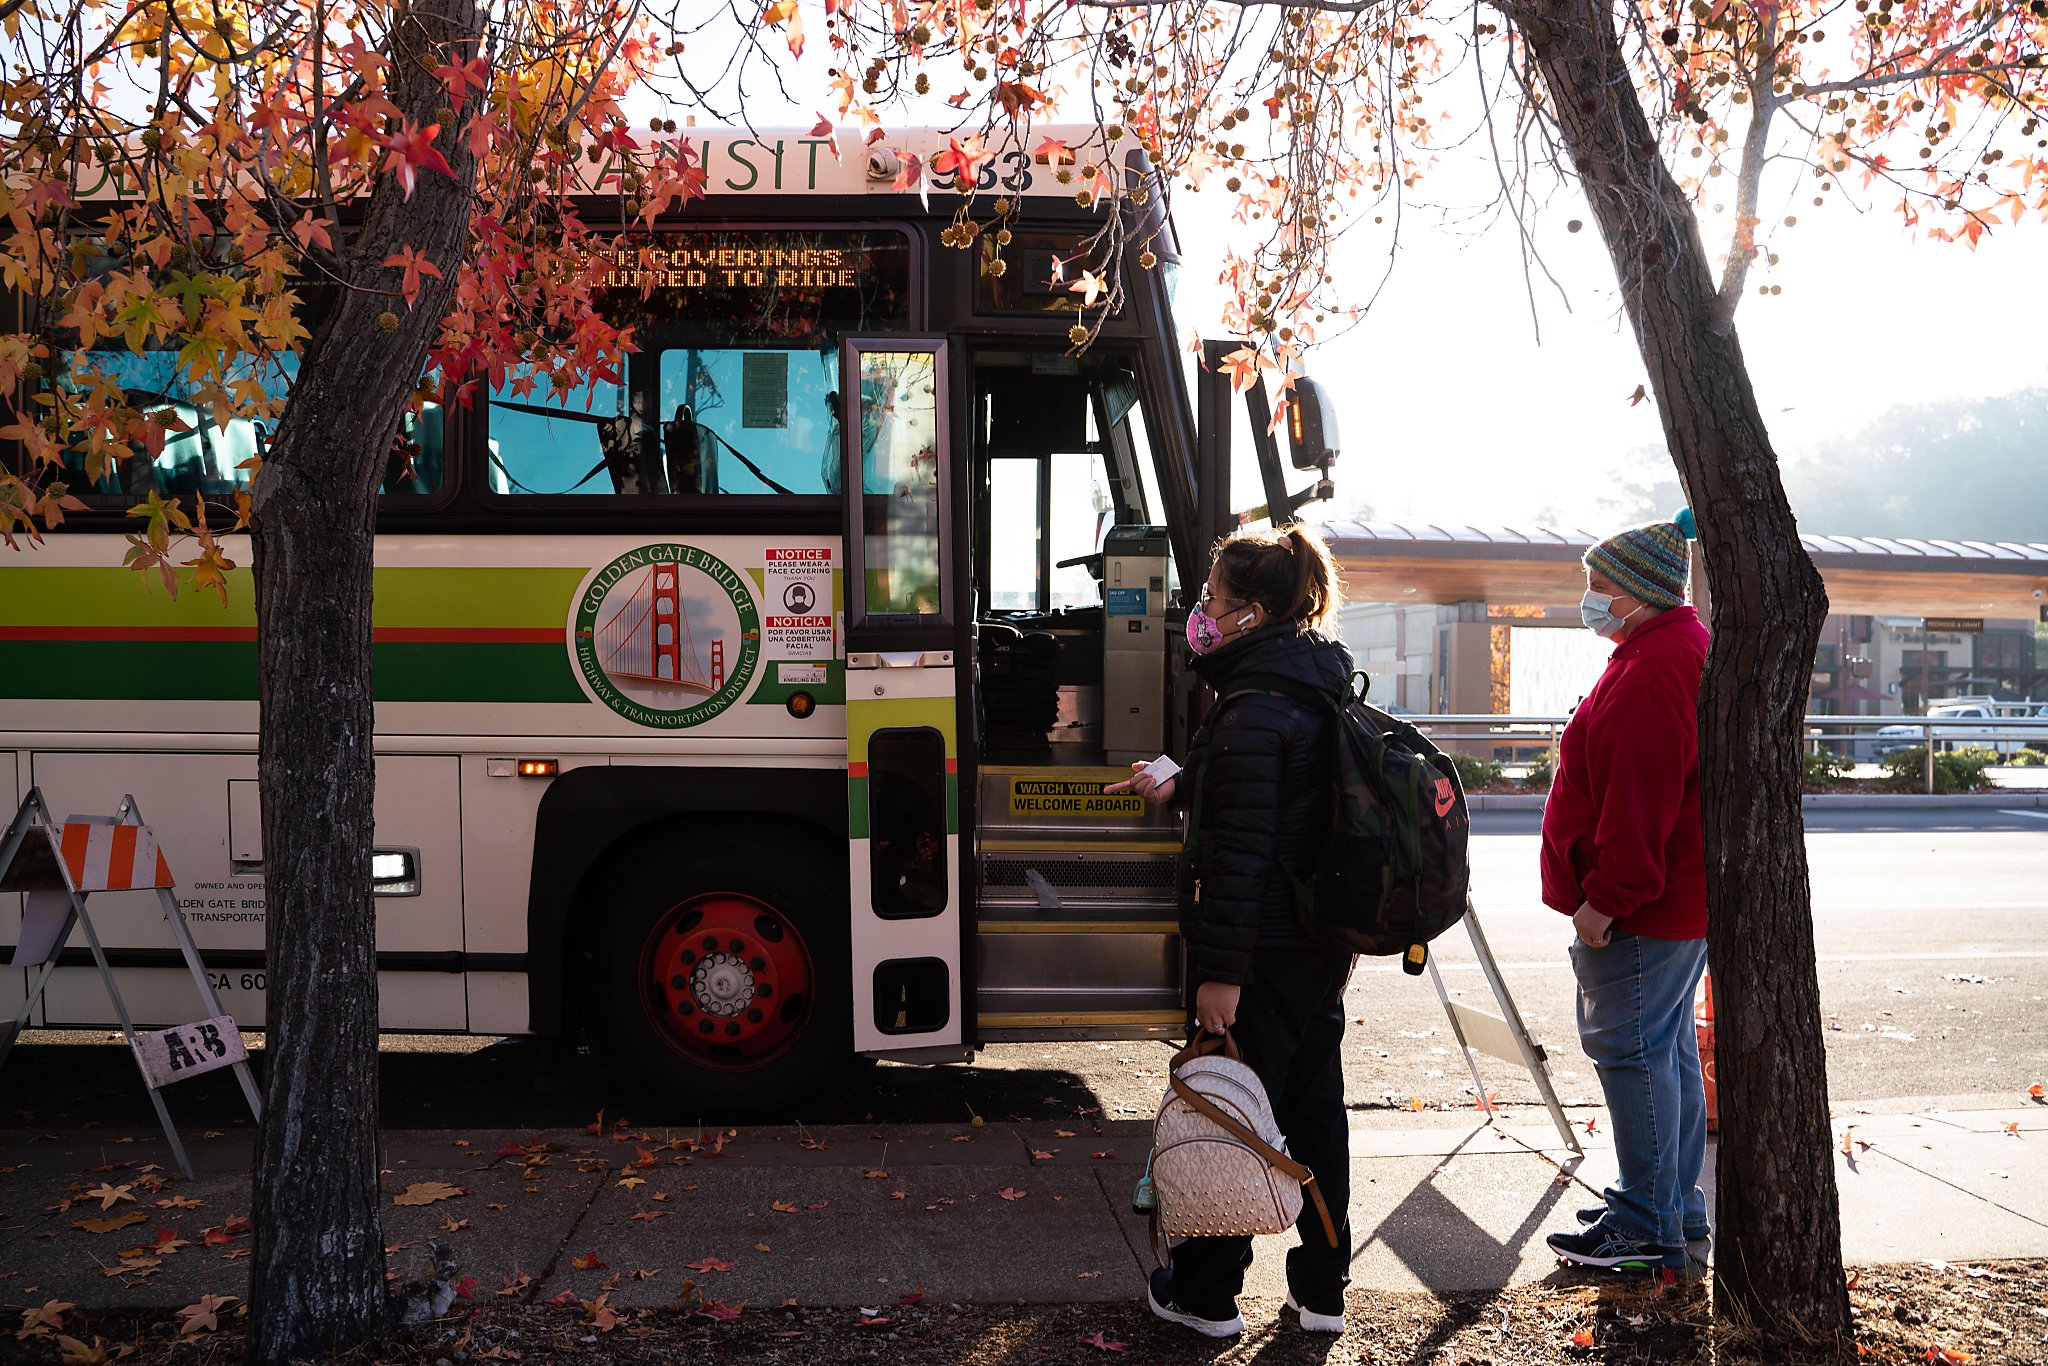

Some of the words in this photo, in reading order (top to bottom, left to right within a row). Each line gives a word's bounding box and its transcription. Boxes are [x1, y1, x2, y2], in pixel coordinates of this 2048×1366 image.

[650, 250, 842, 267] COVERINGS
[722, 270, 763, 287] TO
[778, 270, 855, 287] RIDE
[775, 549, 823, 560] NOTICE
[584, 551, 644, 614] GOLDEN
[648, 546, 696, 564] GATE
[700, 554, 753, 614] BRIDGE
[773, 616, 826, 627] NOTICIA
[579, 647, 614, 699] HIGHWAY
[612, 698, 621, 709] &
[623, 697, 728, 725] TRANSPORTATION
[726, 647, 757, 700] DISTRICT
[1020, 783, 1064, 795] WATCH
[1067, 783, 1100, 795] YOUR
[1014, 798, 1081, 811] WELCOME
[1085, 799, 1141, 811] ABOARD
[194, 882, 225, 890] OWNED
[227, 882, 245, 890] AND
[178, 899, 204, 909] LDEN
[208, 899, 236, 909] GATE
[207, 972, 232, 990] CA
